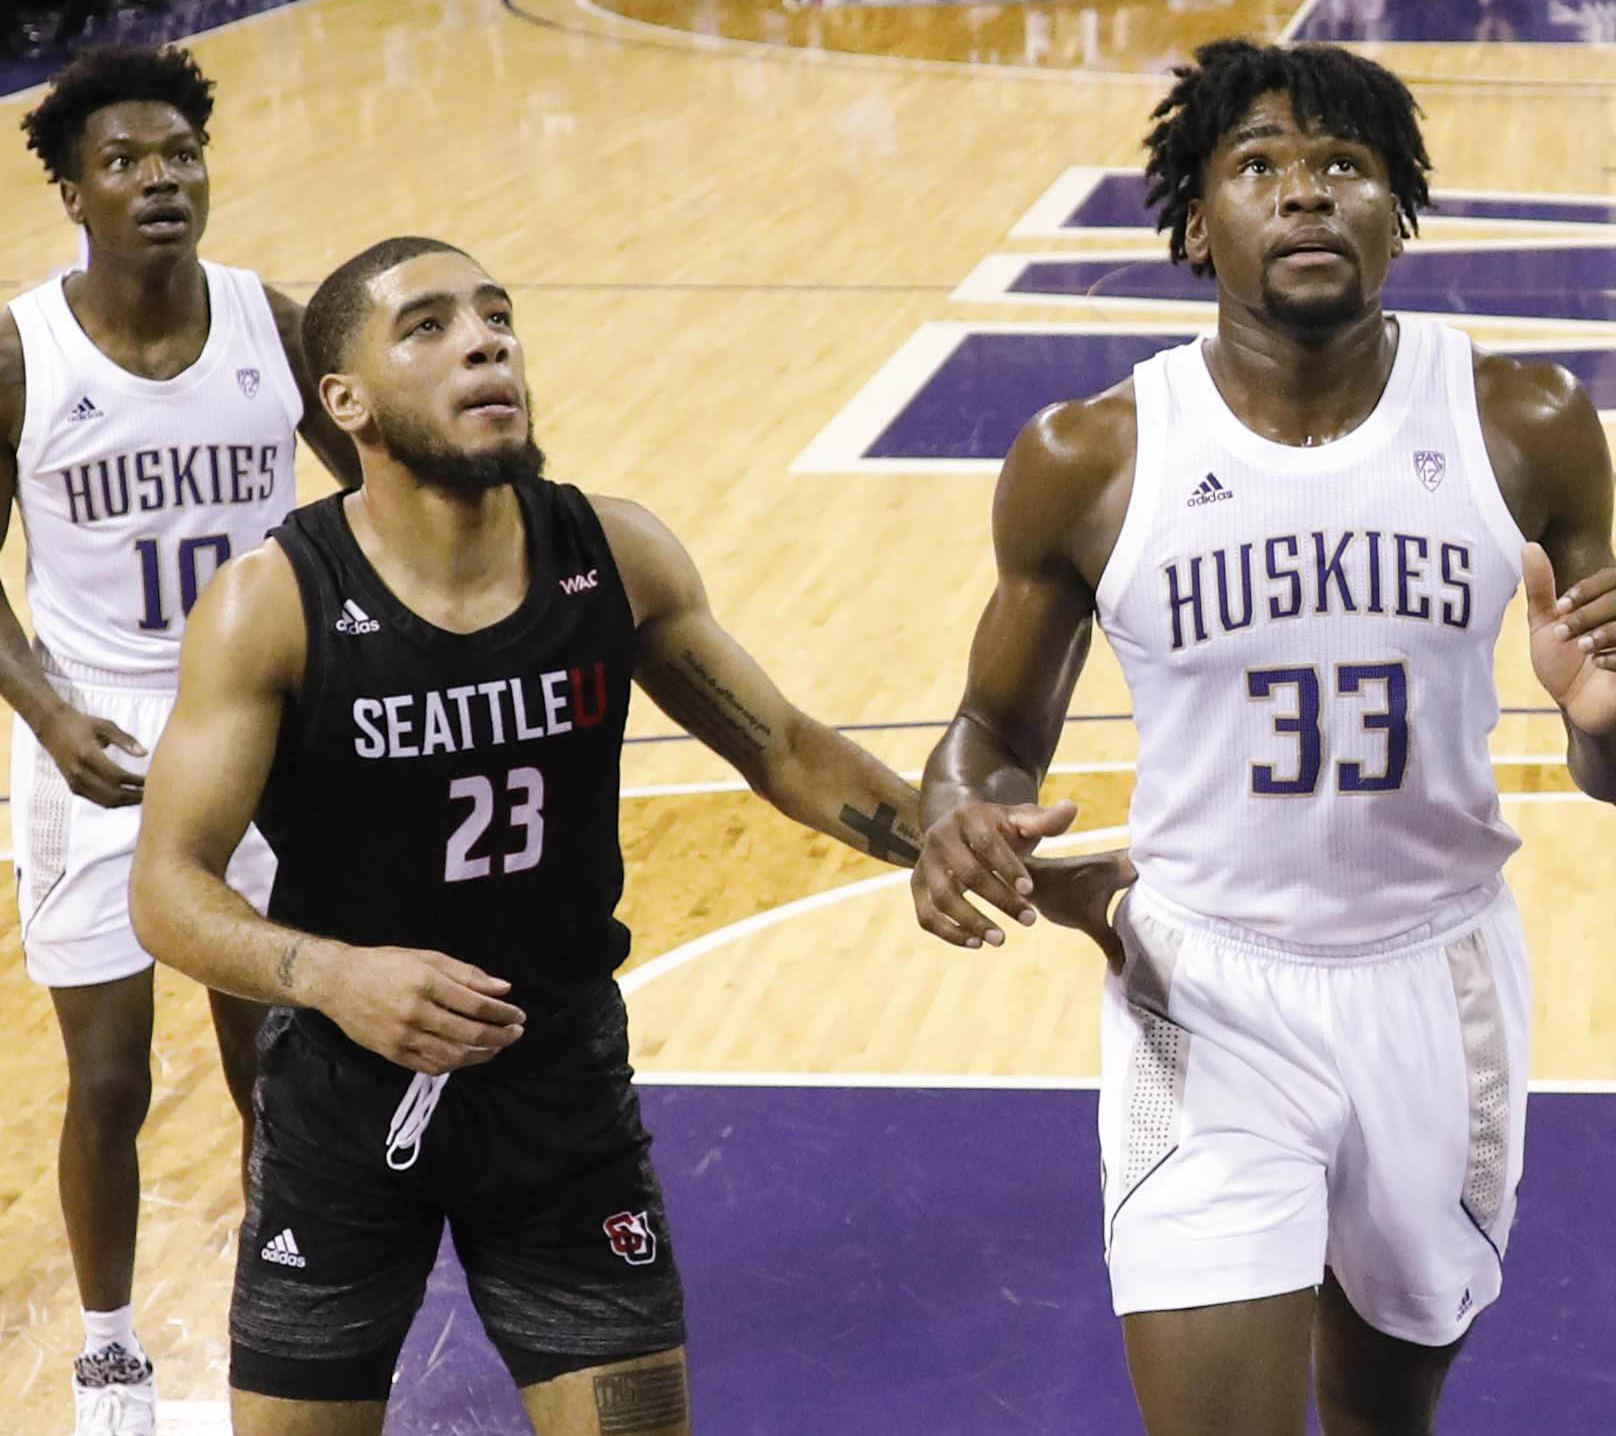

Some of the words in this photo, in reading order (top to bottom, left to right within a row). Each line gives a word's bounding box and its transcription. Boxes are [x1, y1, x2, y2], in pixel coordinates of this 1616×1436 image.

[61, 442, 280, 524] HUSKIES
[1186, 487, 1234, 508] adidas
[134, 532, 234, 633] 10
[559, 567, 599, 596] WAC
[1163, 529, 1476, 653] HUSKIES
[1244, 659, 1414, 798] 33
[443, 764, 547, 883] 23
[260, 1244, 306, 1269] adidas
